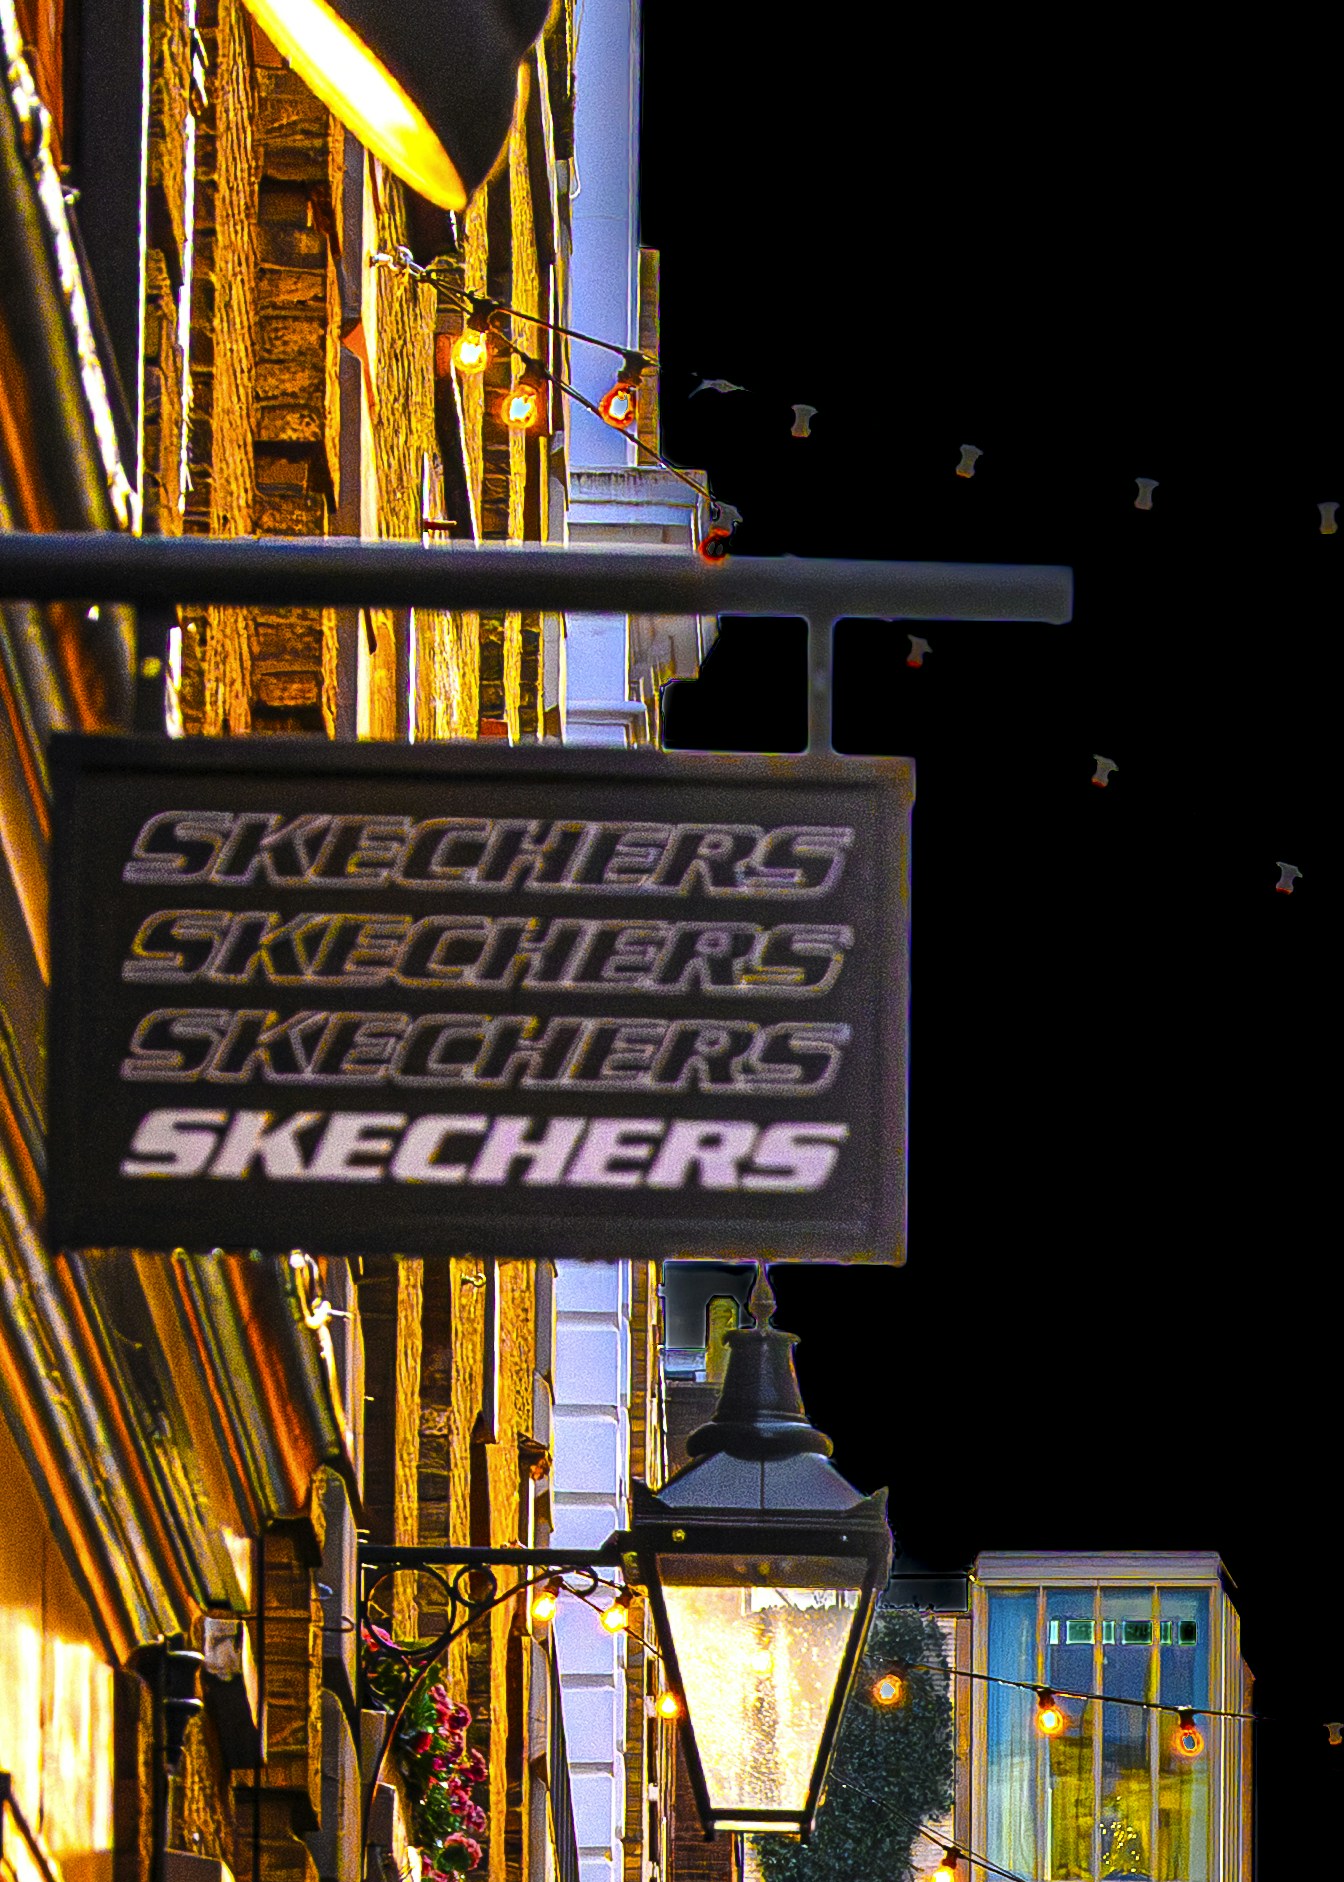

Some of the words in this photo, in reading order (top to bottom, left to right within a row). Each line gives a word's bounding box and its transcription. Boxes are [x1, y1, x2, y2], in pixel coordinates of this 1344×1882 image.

[122, 810, 855, 900] SKECHERS
[121, 909, 854, 997] SKECHERS
[120, 1007, 851, 1095] SKECHERS
[119, 1107, 850, 1192] SKECHERS
